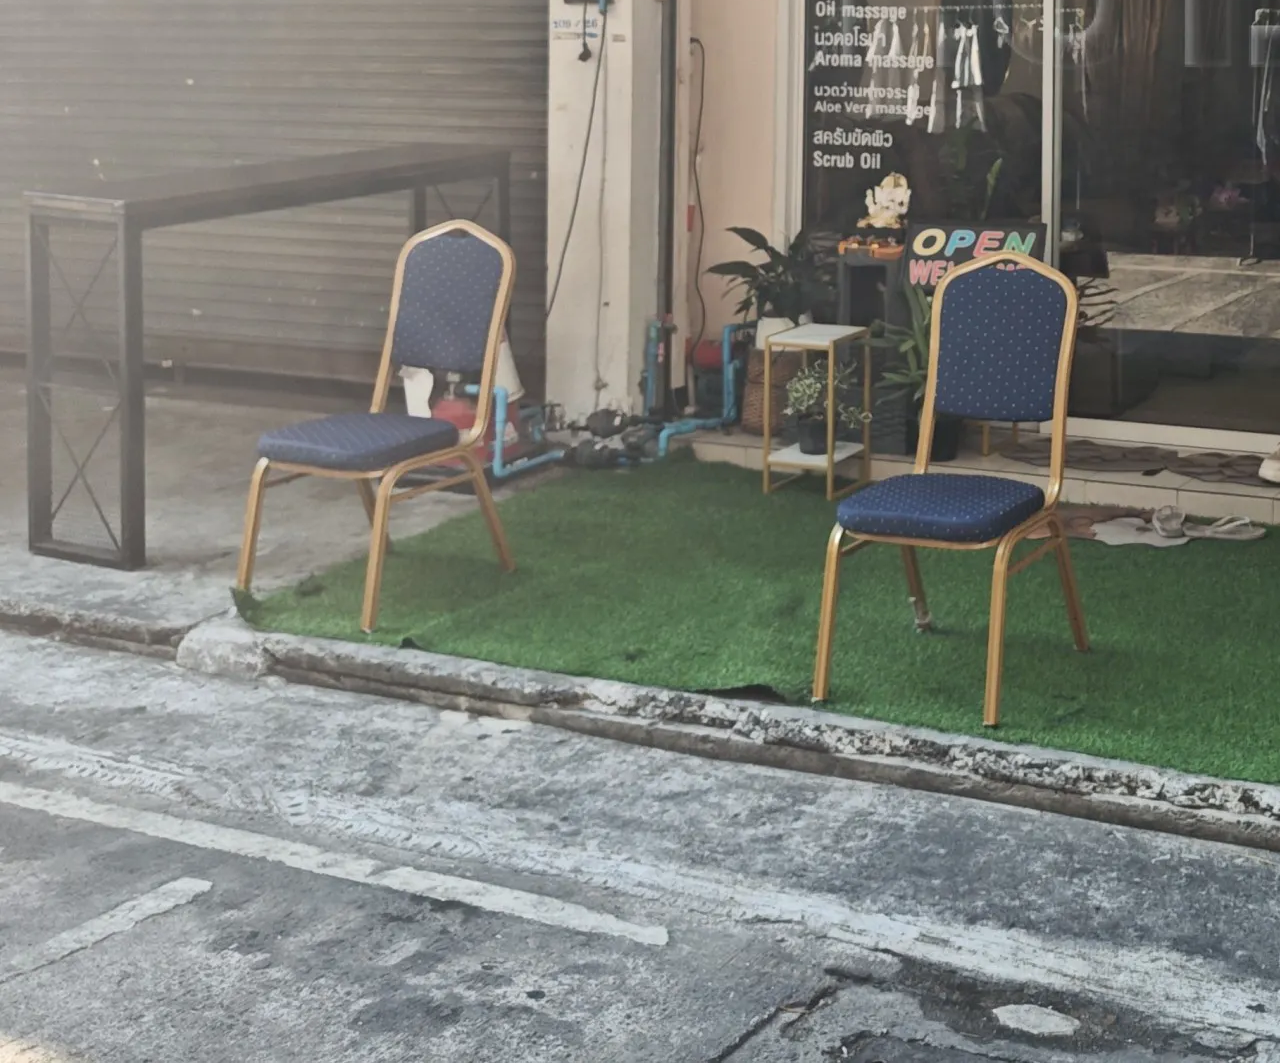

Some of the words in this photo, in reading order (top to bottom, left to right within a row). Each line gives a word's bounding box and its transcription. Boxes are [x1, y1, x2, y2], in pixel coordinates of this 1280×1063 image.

[816, 0, 835, 17] Oil
[842, 6, 907, 21] massage
[815, 51, 862, 68] Aroma
[868, 55, 934, 72] massage
[814, 101, 842, 113] Aloe
[813, 151, 854, 169] Scrub
[861, 153, 881, 169] Oil
[912, 227, 1036, 258] OPEN
